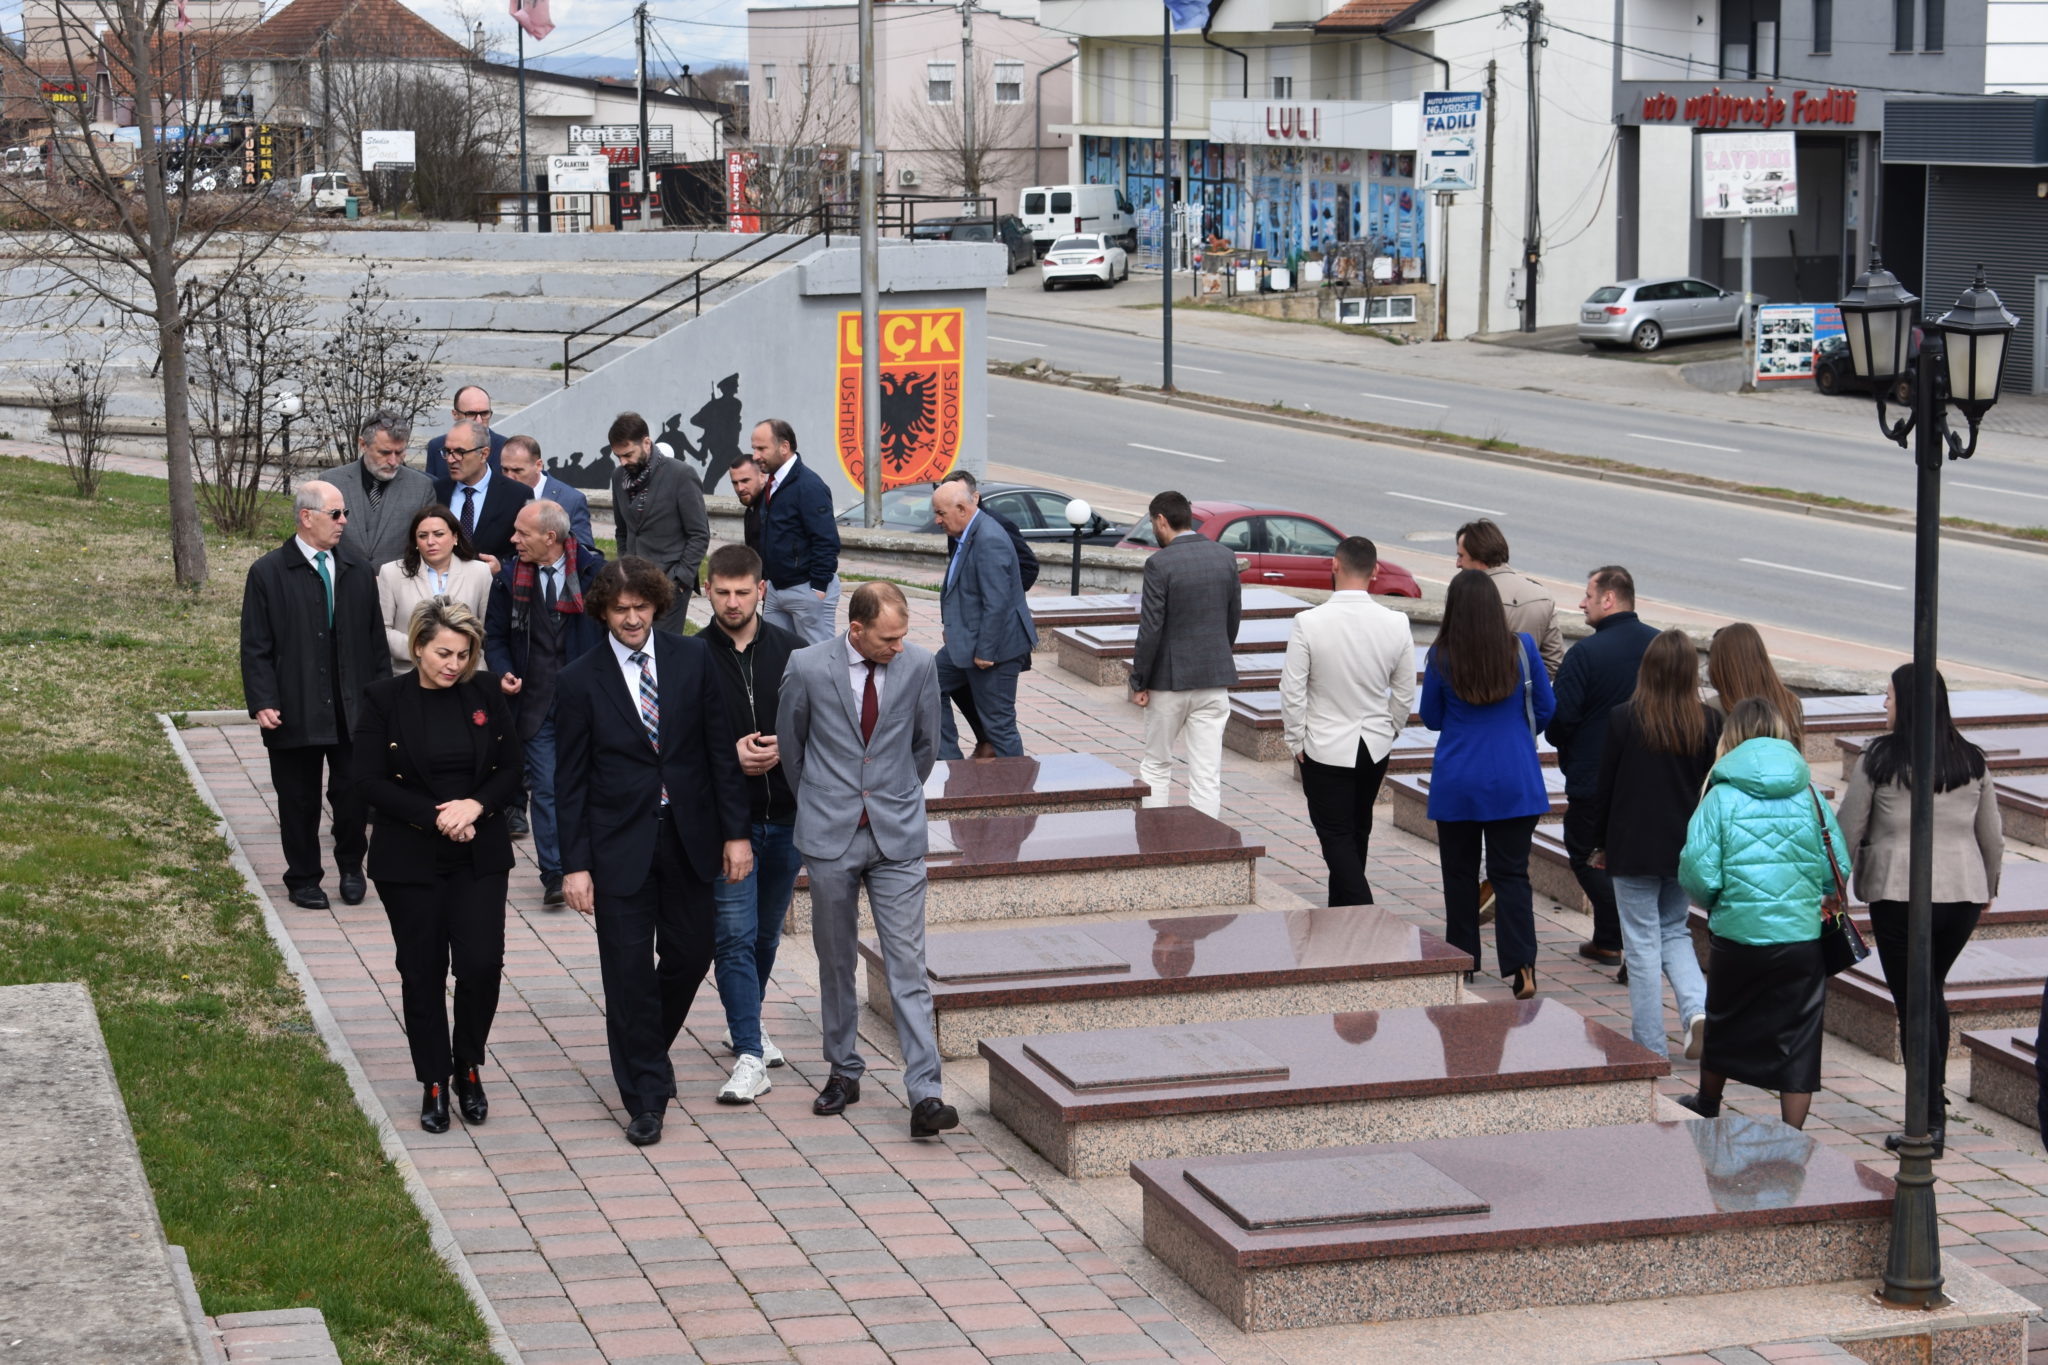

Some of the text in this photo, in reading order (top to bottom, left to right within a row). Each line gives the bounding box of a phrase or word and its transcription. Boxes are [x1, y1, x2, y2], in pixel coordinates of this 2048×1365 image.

[1267, 106, 1318, 139] LULI
[1426, 113, 1476, 132] FADILI
[1427, 102, 1476, 114] NGJYROSJE
[1684, 86, 1786, 128] ngjyrosje
[1792, 87, 1858, 124] Fadili
[570, 125, 671, 142] Rent a ar
[1748, 207, 1763, 215] 044
[846, 315, 955, 362] UÇK
[841, 377, 857, 458] USHTRIA
[940, 371, 958, 458] KOSOVES
